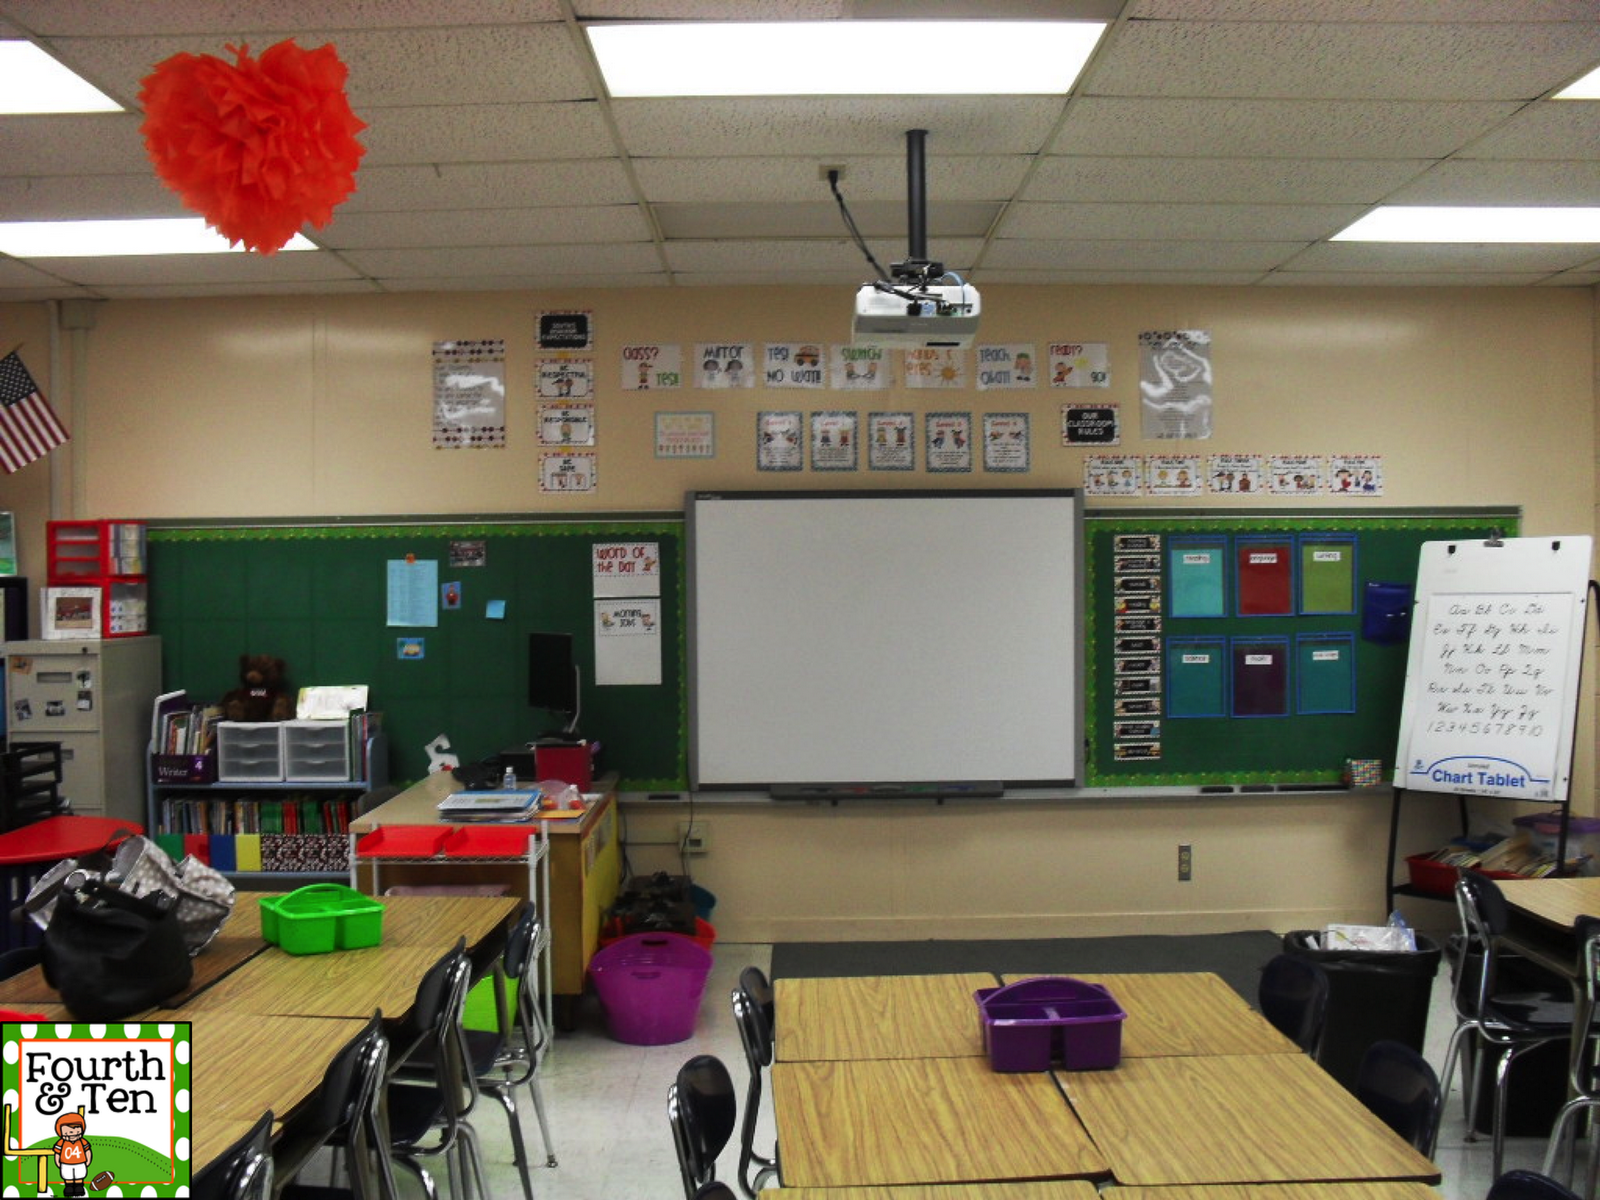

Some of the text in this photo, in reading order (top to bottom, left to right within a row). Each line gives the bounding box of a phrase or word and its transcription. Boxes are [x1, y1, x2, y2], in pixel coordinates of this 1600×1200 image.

[1082, 412, 1098, 420] OUR
[1432, 769, 1526, 788] Chart Tablet
